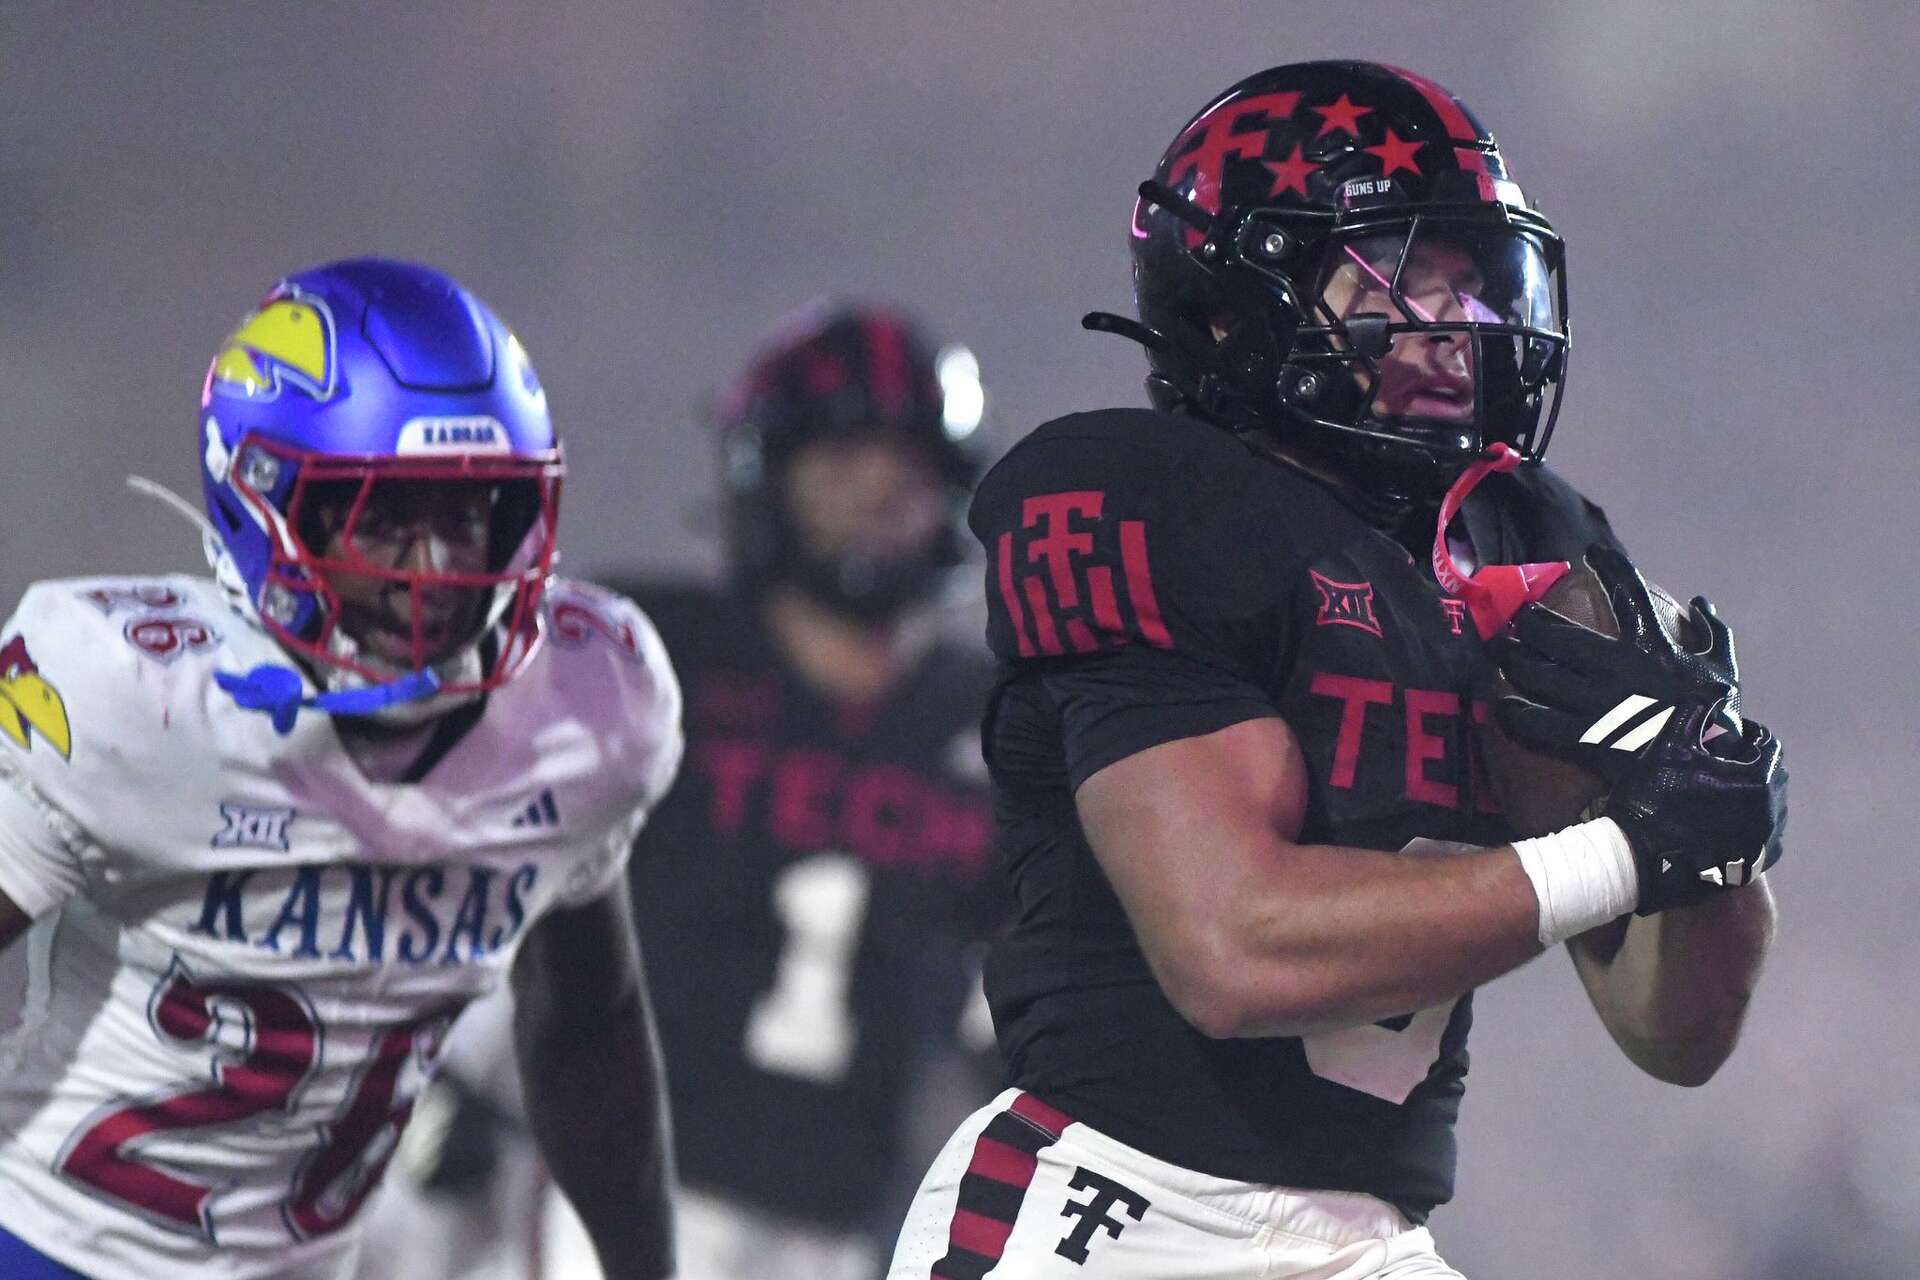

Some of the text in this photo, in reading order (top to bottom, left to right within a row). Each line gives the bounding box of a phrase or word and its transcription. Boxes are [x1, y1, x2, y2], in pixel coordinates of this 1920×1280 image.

[1344, 179, 1391, 197] GUNS UP
[187, 863, 538, 964] KANSAS
